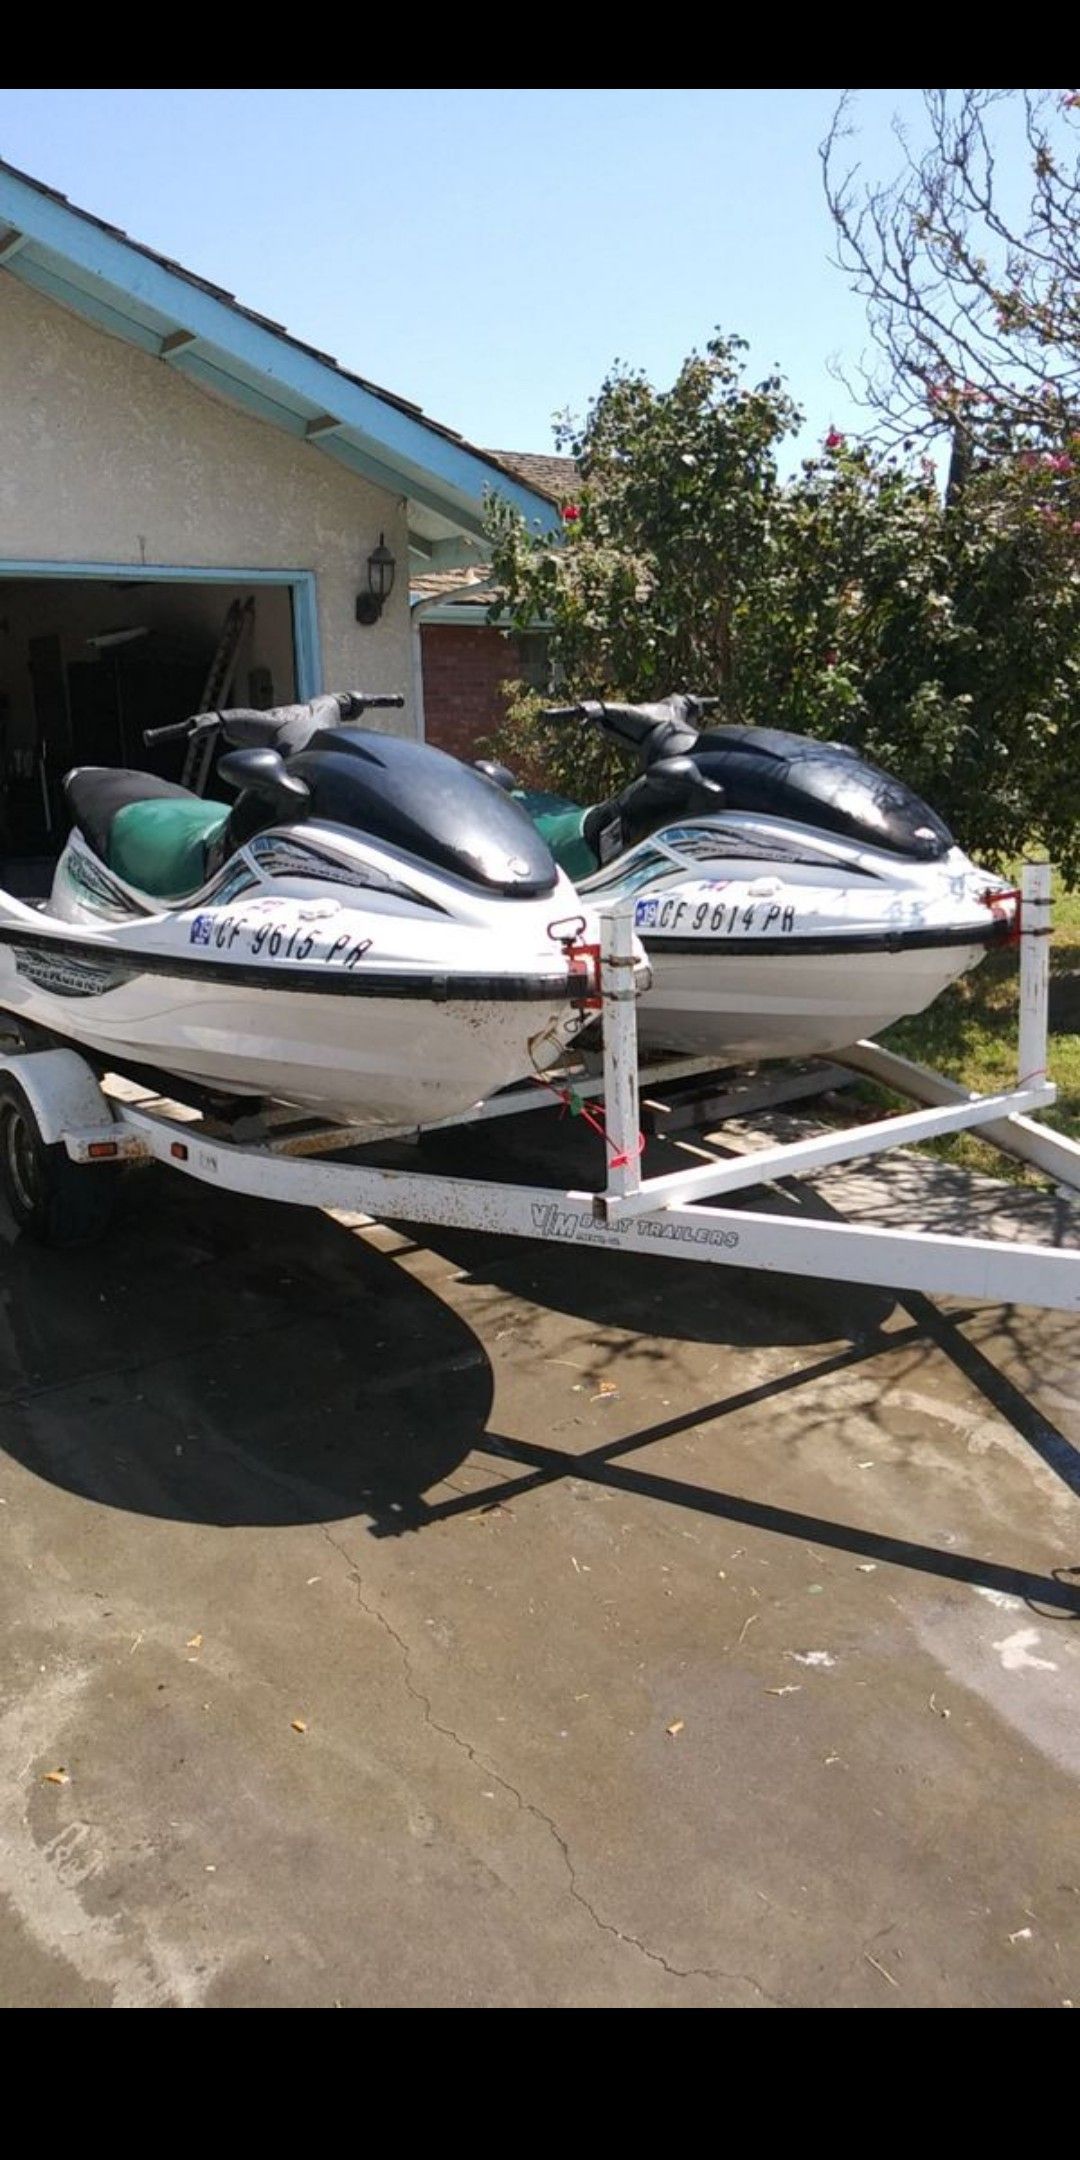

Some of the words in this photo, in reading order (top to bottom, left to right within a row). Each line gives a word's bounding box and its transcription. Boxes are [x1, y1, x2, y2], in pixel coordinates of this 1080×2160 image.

[660, 900, 688, 929] CF
[692, 902, 755, 934] 9614
[215, 916, 248, 949] CF
[251, 922, 322, 961] 9615
[324, 933, 374, 970] PR
[637, 1218, 740, 1249] TRAILERS
